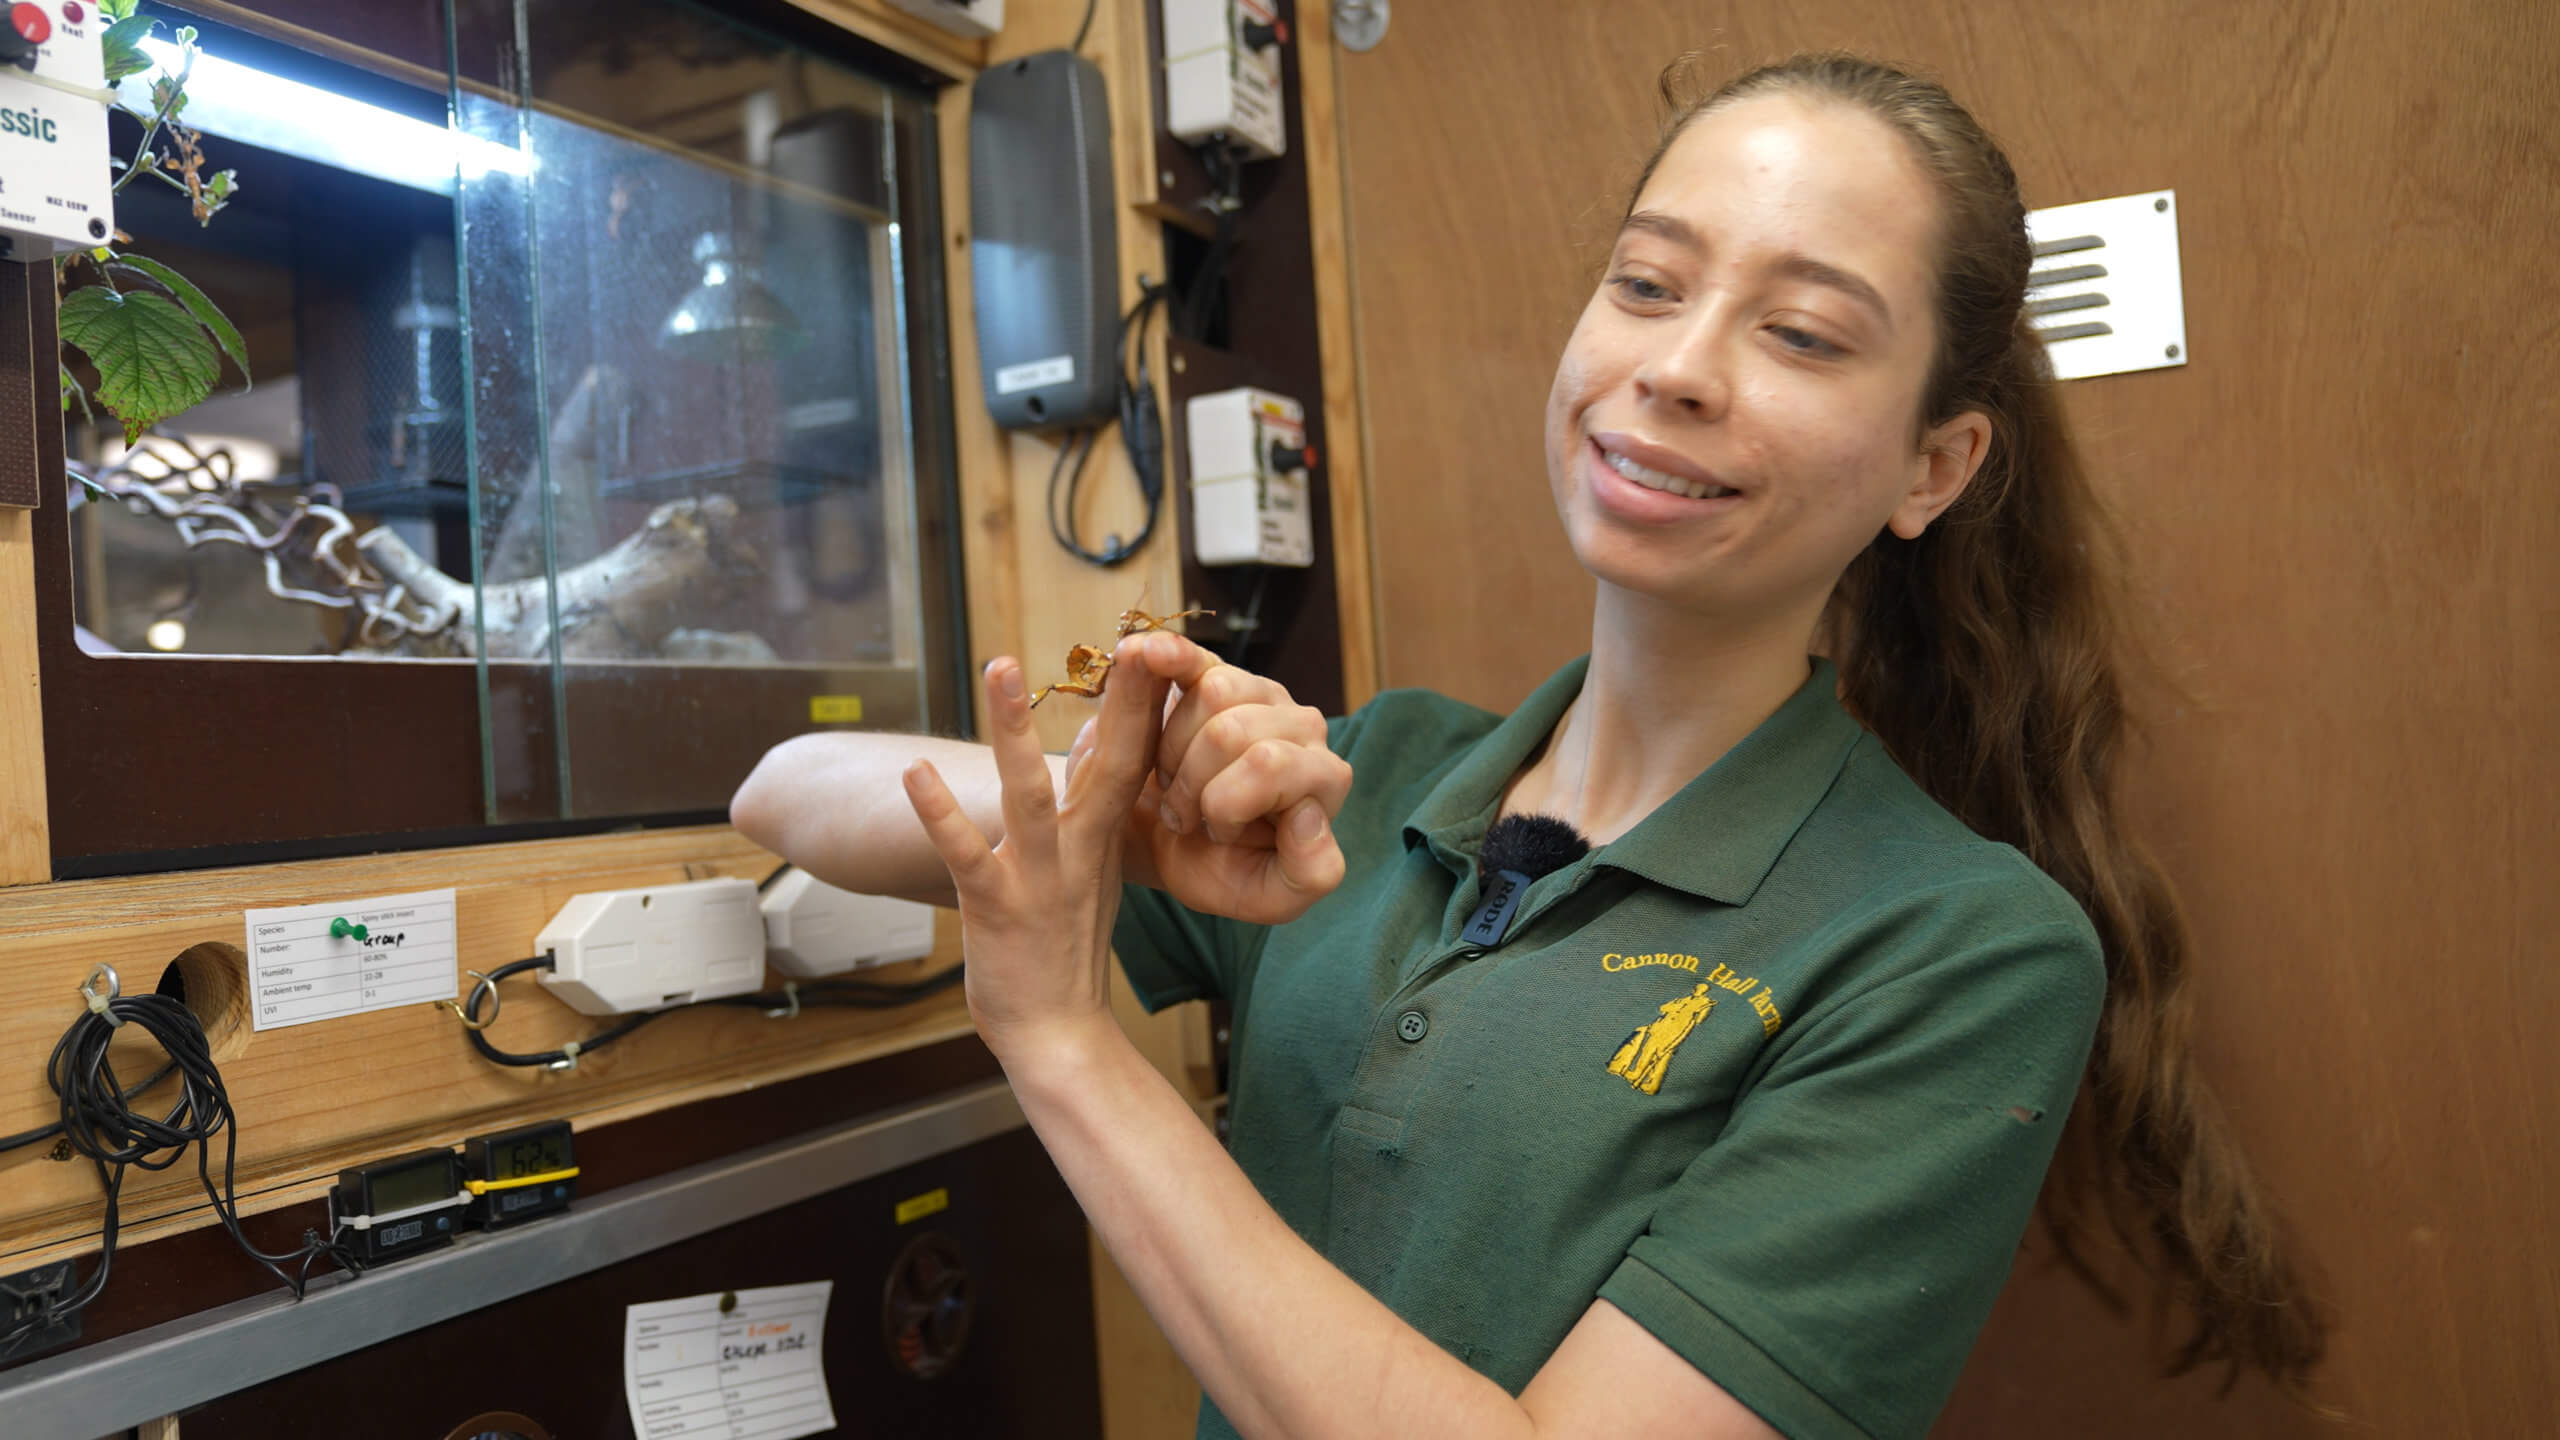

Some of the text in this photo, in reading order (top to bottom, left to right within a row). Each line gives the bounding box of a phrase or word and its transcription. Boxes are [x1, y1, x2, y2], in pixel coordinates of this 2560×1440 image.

[258, 926, 286, 936] Species
[261, 967, 293, 978] Humidity
[263, 983, 313, 996] Ambient temp
[1602, 953, 1783, 1039] Cannon Hall Farm
[263, 1006, 278, 1015] UVI
